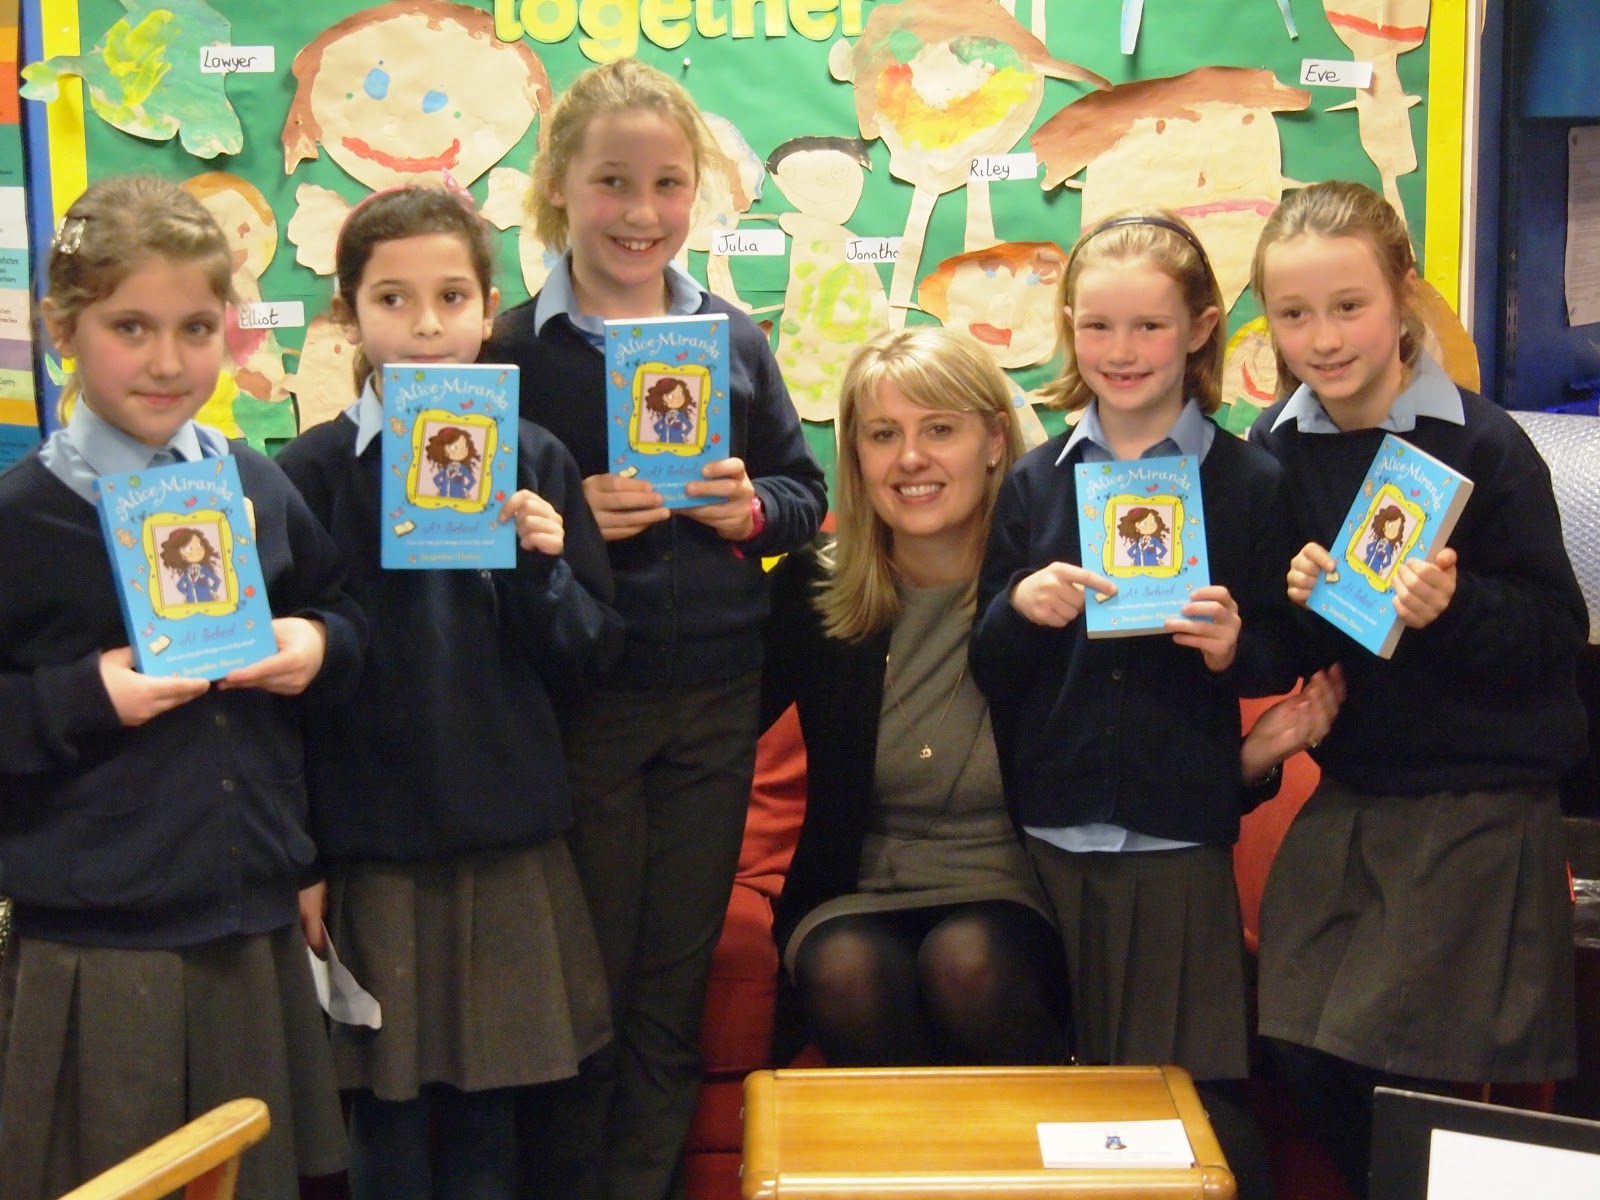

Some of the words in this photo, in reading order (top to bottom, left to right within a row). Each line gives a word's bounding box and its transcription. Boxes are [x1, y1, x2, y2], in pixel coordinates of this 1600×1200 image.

[1305, 64, 1341, 82] Eve
[970, 157, 1010, 181] Riley
[718, 233, 758, 253] Julia
[241, 308, 279, 327] Elliot
